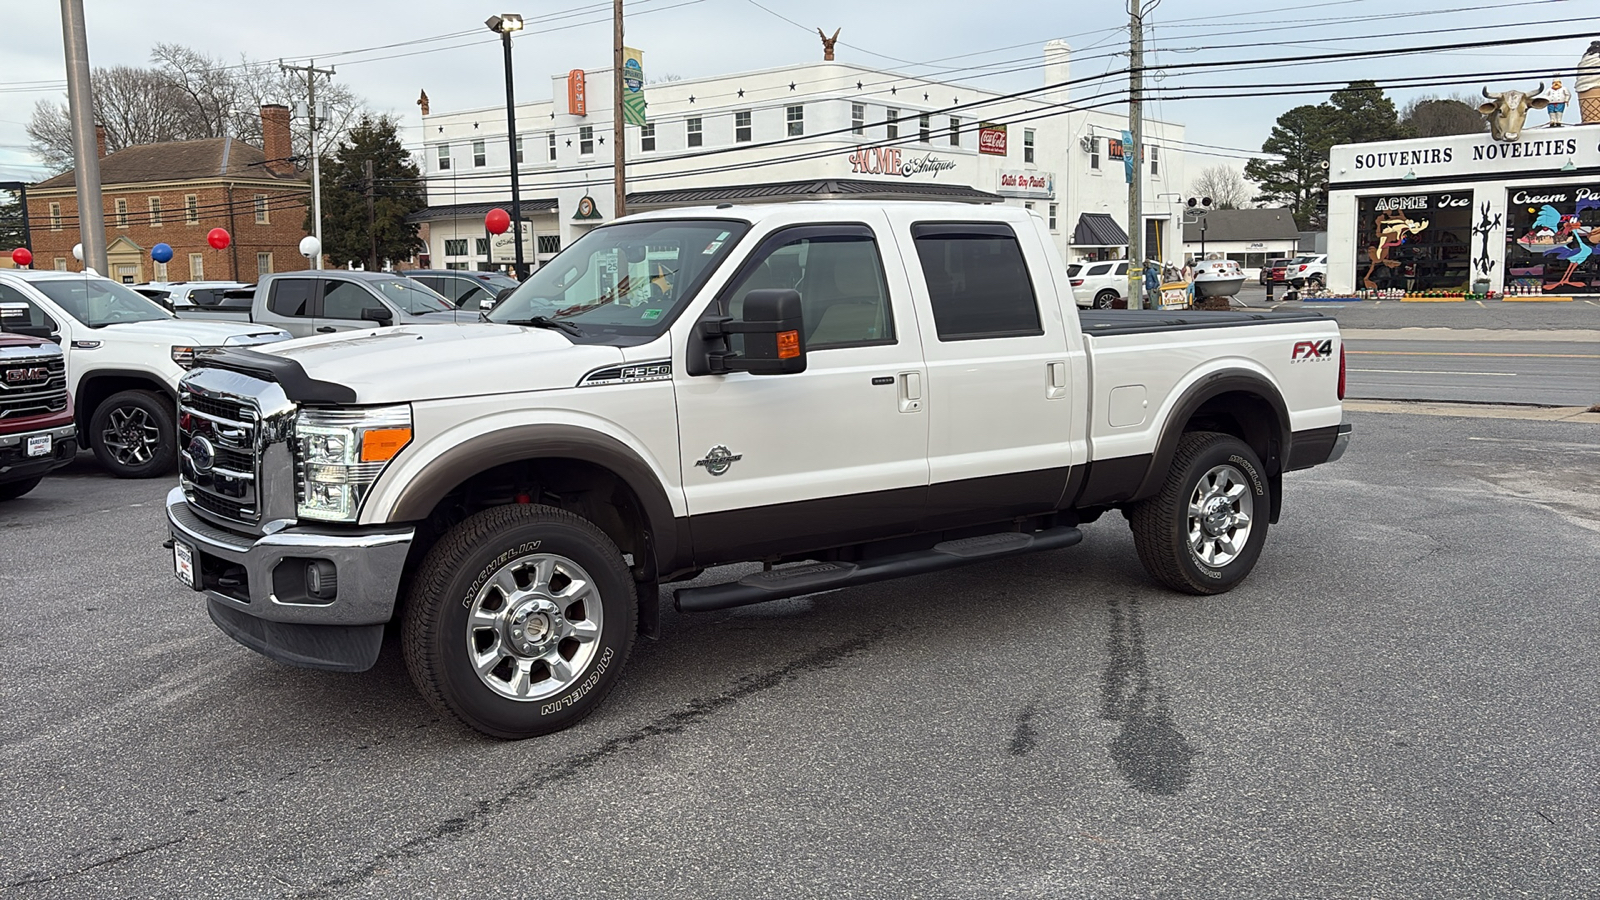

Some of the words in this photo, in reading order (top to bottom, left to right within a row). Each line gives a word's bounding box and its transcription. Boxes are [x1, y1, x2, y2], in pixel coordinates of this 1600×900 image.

[576, 73, 584, 112] ACME
[849, 145, 902, 176] ACME
[902, 152, 957, 178] Antiques
[1355, 147, 1453, 169] SOUVENIRS
[1473, 139, 1577, 160] NOVELTIES
[1001, 174, 1017, 186] Dutch
[1018, 175, 1029, 189] Boy
[1029, 176, 1046, 188] Paints
[1375, 195, 1428, 211] ACME
[1438, 194, 1471, 208] Ice
[1512, 190, 1568, 204] Cream
[1291, 339, 1332, 359] FX4
[6, 367, 49, 382] GMC
[29, 437, 50, 446] BAREFORD
[1228, 455, 1264, 496] MICHELIN
[462, 540, 542, 609] MICHELIN
[541, 647, 614, 716] MICHELIN
